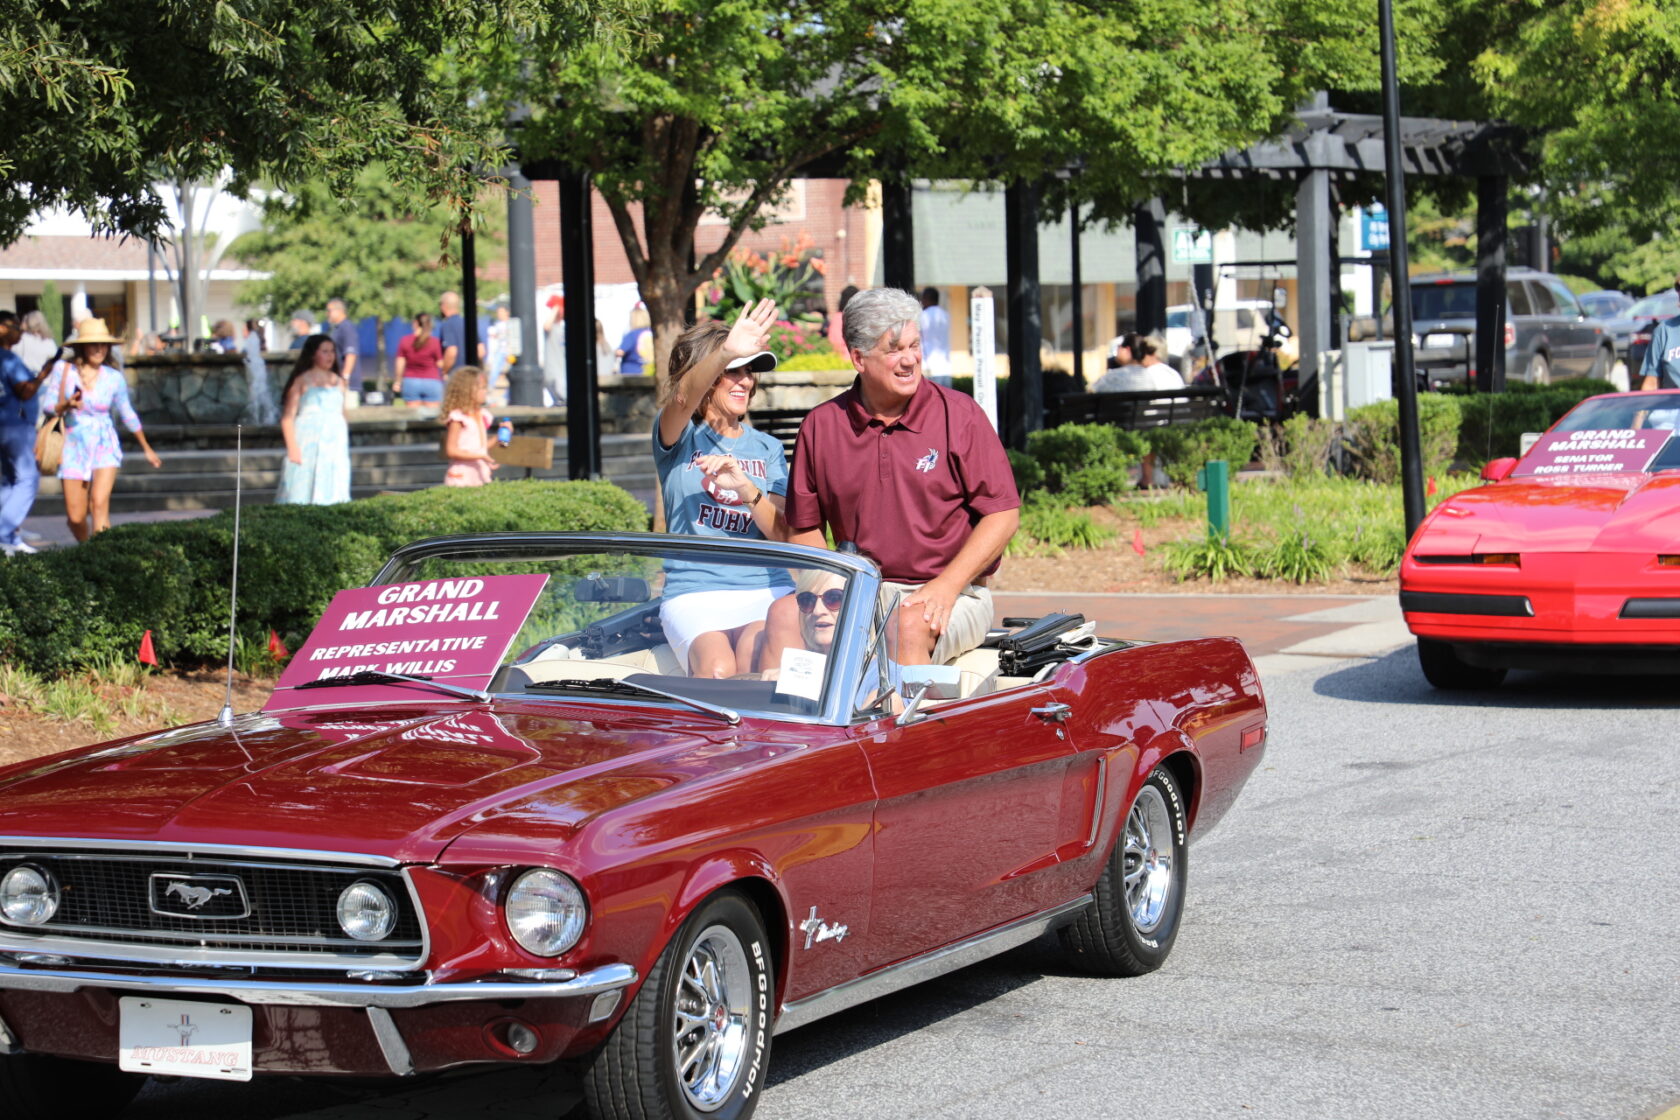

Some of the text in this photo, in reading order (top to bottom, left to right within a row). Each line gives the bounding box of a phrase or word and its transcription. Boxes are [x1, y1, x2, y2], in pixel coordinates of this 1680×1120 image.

[1570, 429, 1636, 441] GRAND
[1547, 439, 1646, 452] MARSHALL
[1534, 463, 1624, 474] ROSS TURNER
[1554, 454, 1614, 464] SENATOR
[696, 502, 753, 534] FURY
[377, 579, 485, 605] GRAND
[338, 600, 501, 631] MARSHALL
[309, 635, 488, 661] REPRESENTATIVE
[385, 659, 457, 675] WILLIS
[130, 1045, 240, 1067] MUSTANG
